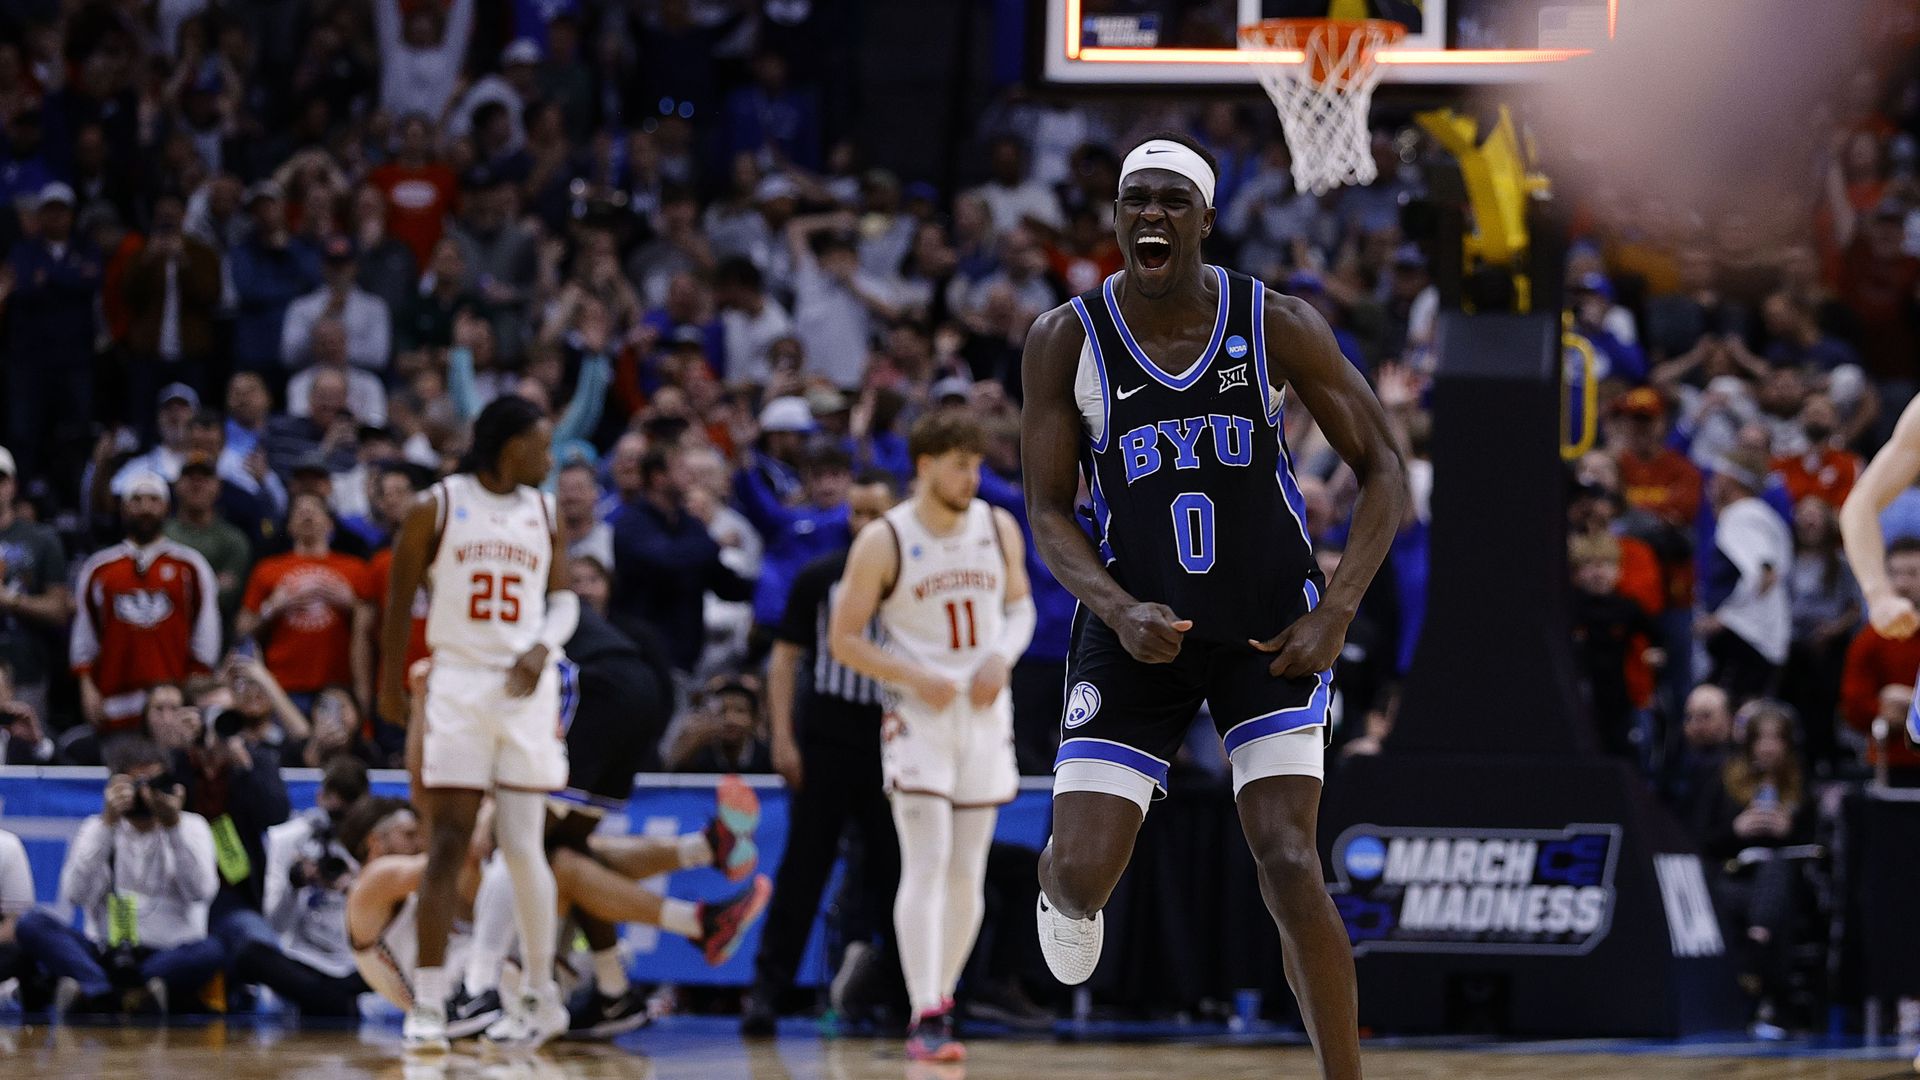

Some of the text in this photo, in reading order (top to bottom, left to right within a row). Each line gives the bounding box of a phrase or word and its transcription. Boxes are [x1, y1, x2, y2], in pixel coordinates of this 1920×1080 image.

[1119, 414, 1254, 486] BYU
[1170, 492, 1216, 574] 0
[468, 573, 522, 622] 25
[944, 600, 977, 650] 11
[1382, 838, 1537, 886] MARCH
[1399, 885, 1606, 933] MADNESS
